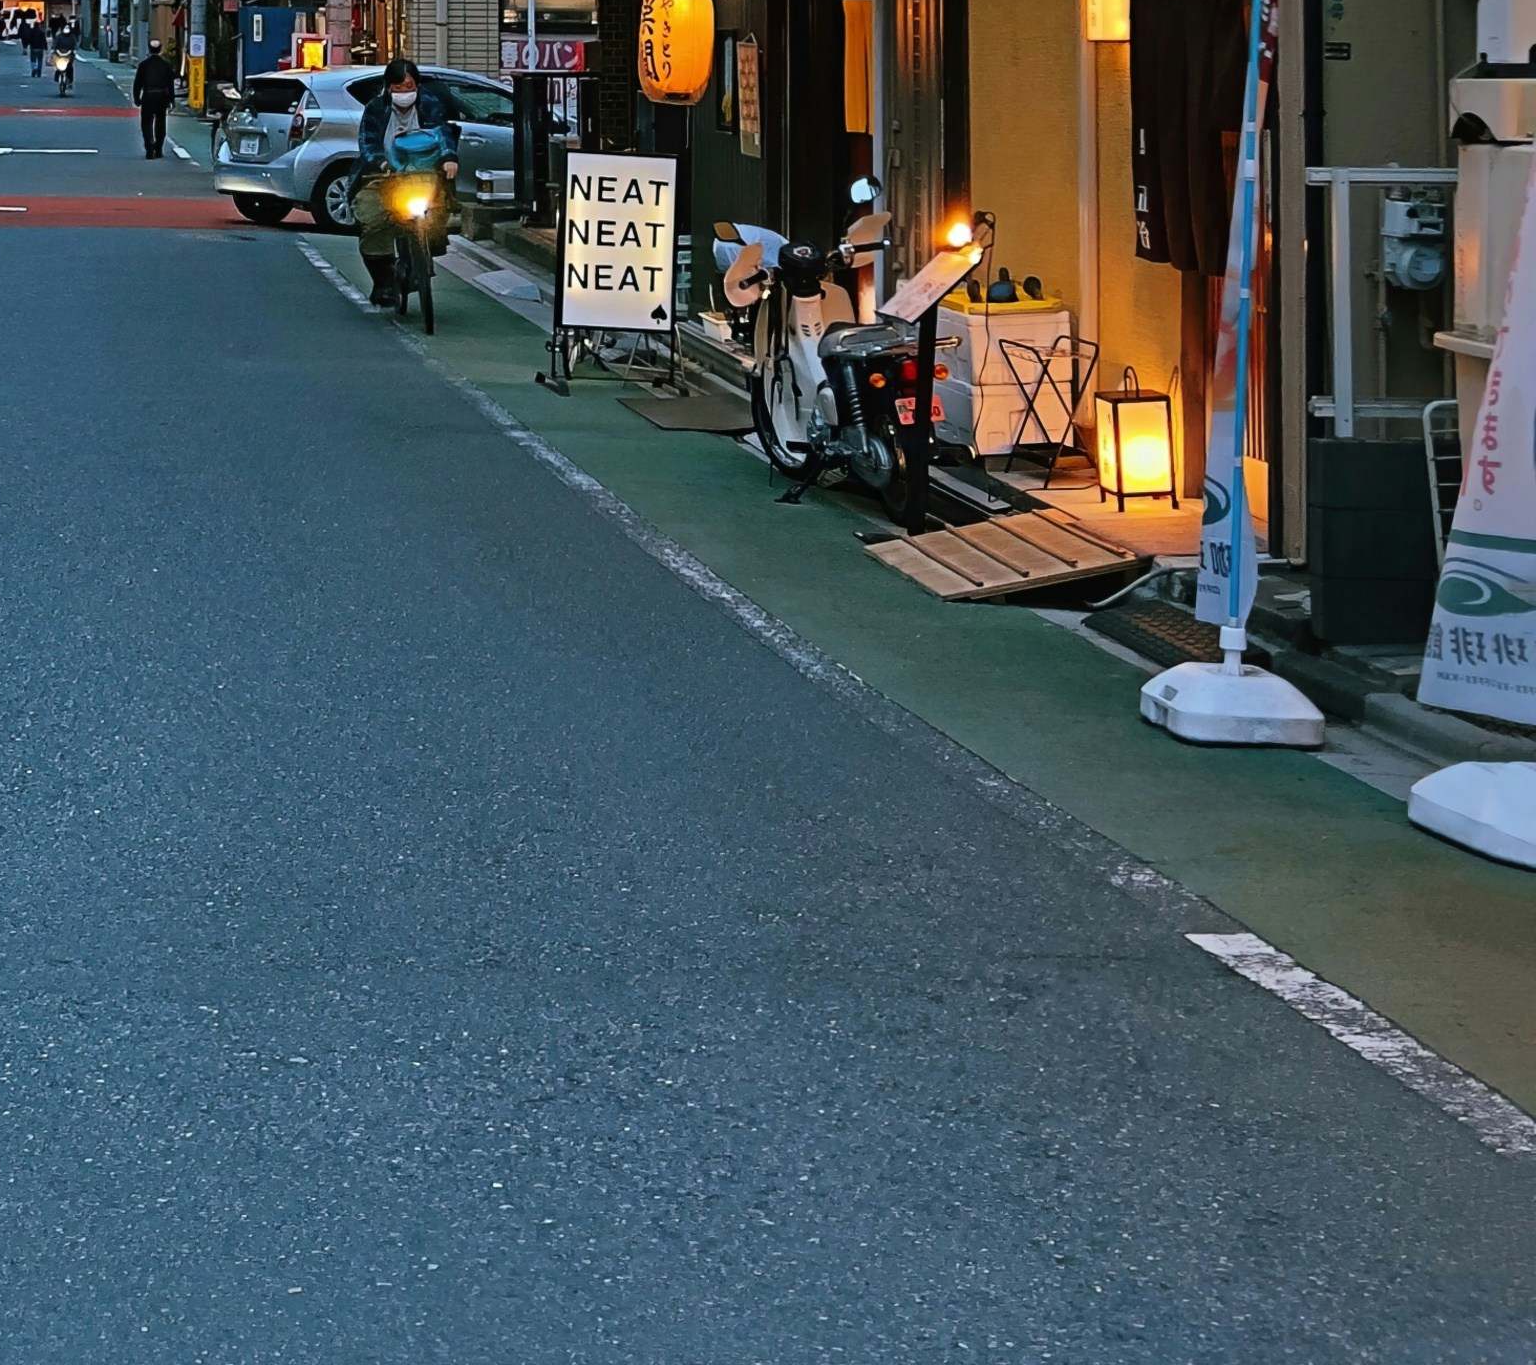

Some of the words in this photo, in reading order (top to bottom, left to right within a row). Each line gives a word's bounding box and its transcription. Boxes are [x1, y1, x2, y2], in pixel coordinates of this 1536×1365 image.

[570, 174, 669, 206] NEAT
[568, 219, 665, 248] NEAT
[568, 263, 663, 292] NEAT
